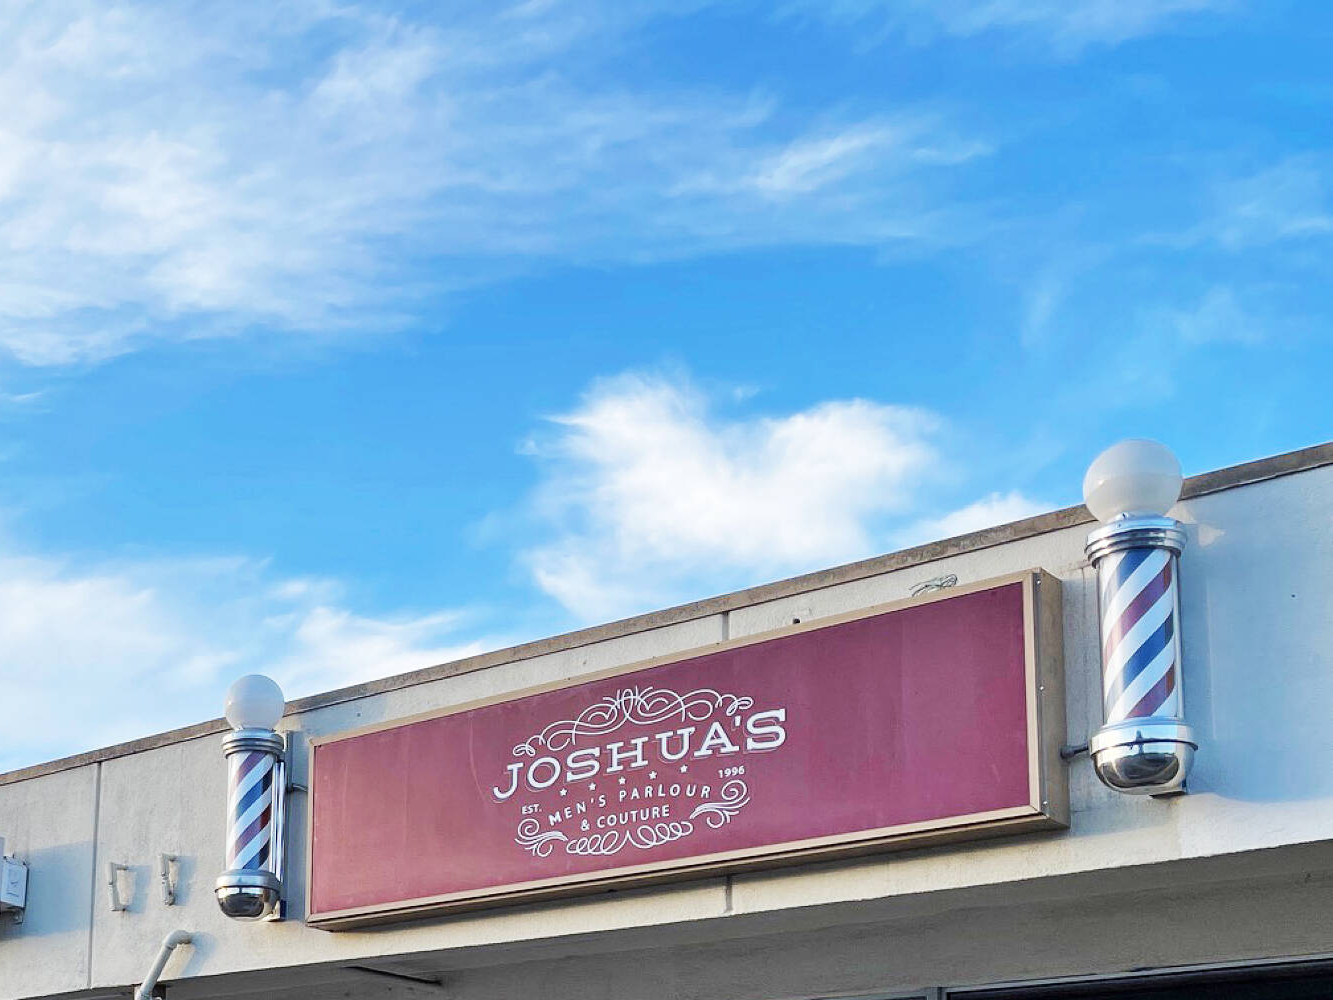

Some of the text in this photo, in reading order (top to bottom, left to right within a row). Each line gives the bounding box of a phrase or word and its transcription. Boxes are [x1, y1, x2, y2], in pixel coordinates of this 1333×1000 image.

[493, 708, 786, 800] JOSHUA'S
[718, 765, 745, 779] 1996
[522, 804, 542, 815] EST.
[548, 784, 712, 826] MEN'S PARLOUR
[580, 805, 670, 831] & COUTURE
